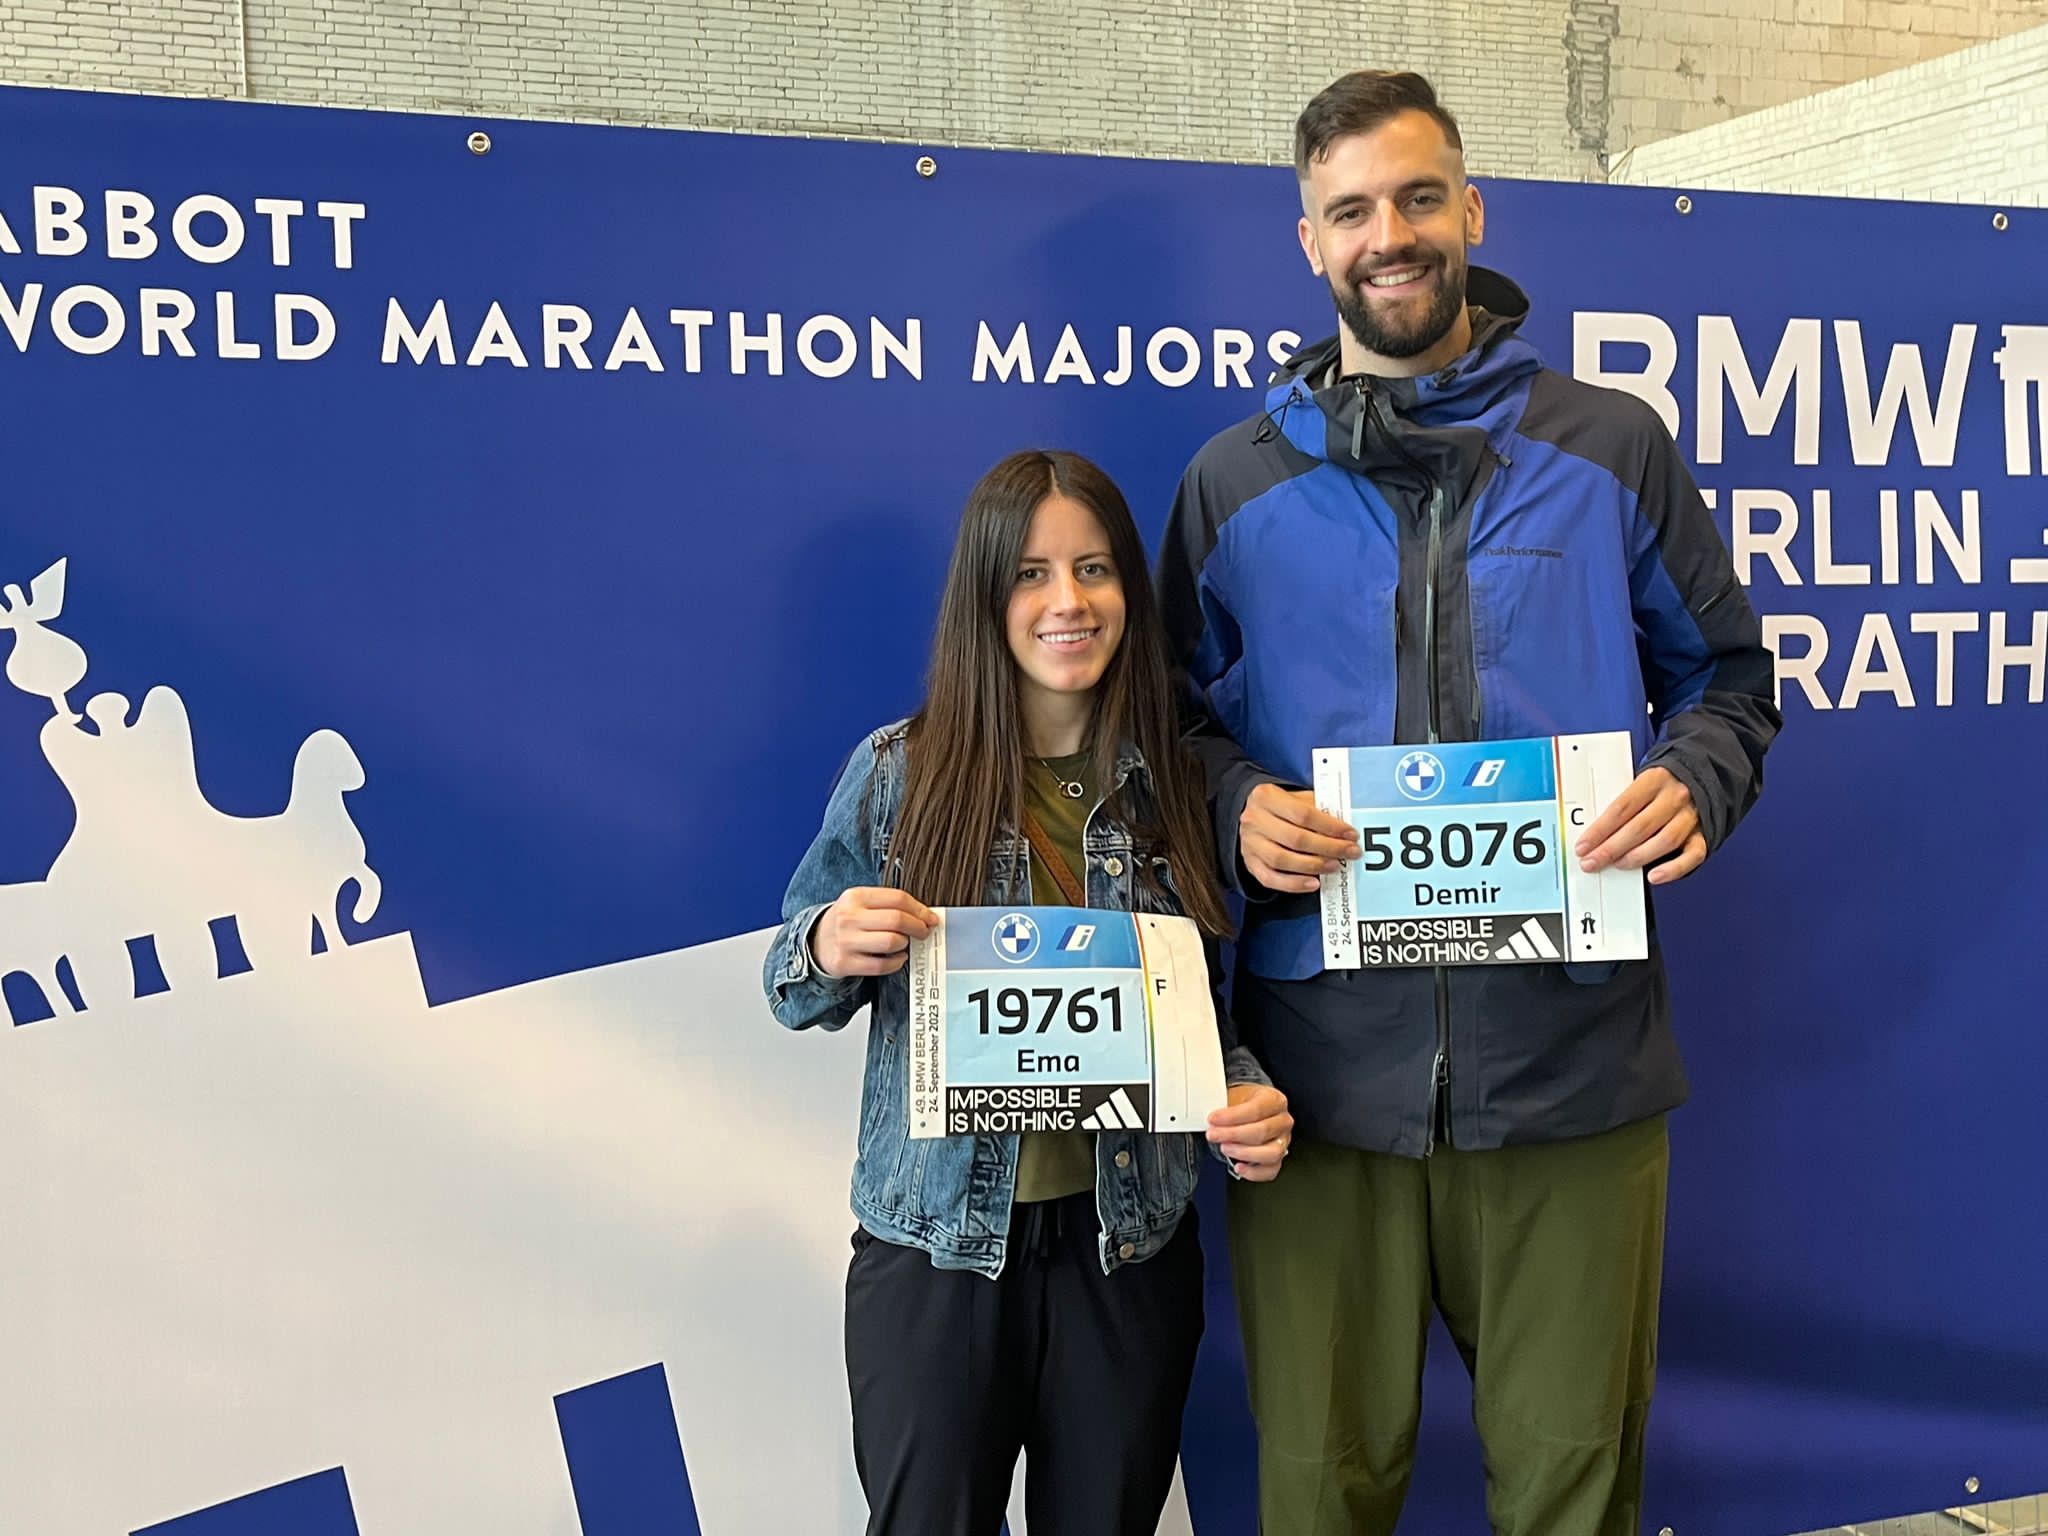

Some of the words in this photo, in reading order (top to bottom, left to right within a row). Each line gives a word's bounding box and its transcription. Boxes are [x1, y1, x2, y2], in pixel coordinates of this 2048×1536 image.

[380, 297, 922, 381] MARATHON
[971, 319, 1302, 390] MAJORS
[1573, 311, 1978, 467] BMW
[1571, 808, 1585, 826] C
[1363, 819, 1547, 872] 58076
[1339, 870, 1352, 927] September
[1414, 881, 1501, 906] Demir
[1342, 929, 1352, 945] 24.
[1361, 918, 1494, 943] IMPOSSIBLE
[1363, 946, 1383, 965] IS
[1387, 941, 1490, 964] NOTHING
[914, 942, 926, 1058] BERLIN-MARATHO
[1155, 979, 1167, 996] F
[928, 1004, 940, 1031] 2023
[968, 986, 1122, 1034] 19761
[928, 1034, 940, 1094] September
[1017, 1049, 1080, 1073] Ema
[915, 1061, 926, 1092] BMW
[915, 1095, 926, 1114] 49.
[928, 1096, 939, 1113] 24.
[949, 1088, 1082, 1110] IMPOSSIBLE
[949, 1112, 969, 1133] IS
[973, 1110, 1076, 1133] NOTHING
